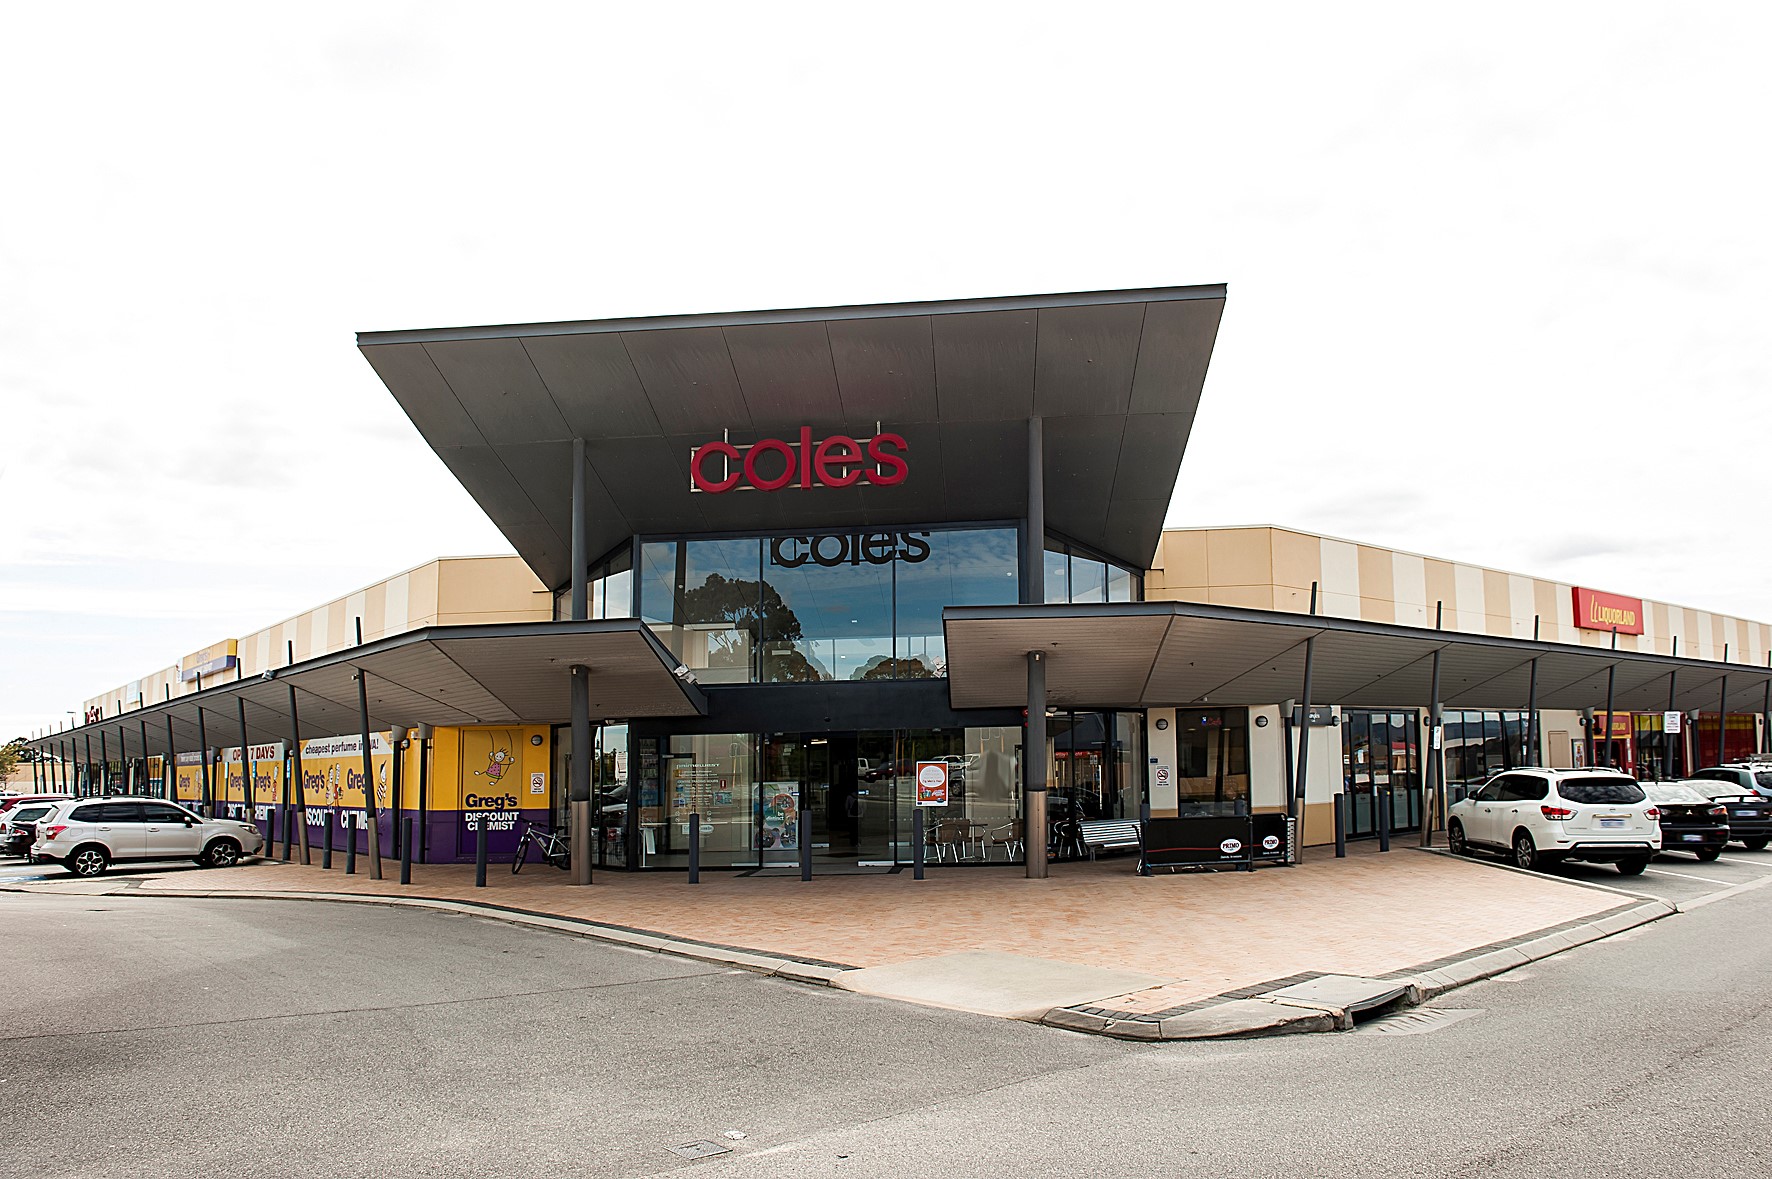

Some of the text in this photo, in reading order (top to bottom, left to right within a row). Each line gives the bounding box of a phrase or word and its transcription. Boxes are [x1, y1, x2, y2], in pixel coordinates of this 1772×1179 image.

[691, 426, 908, 494] coles
[771, 532, 931, 568] coles
[1598, 605, 1636, 626] LIQUORLAND
[250, 747, 255, 759] 7
[256, 745, 275, 759] DAYS
[305, 742, 331, 756] cheapest
[331, 742, 357, 755] perfume
[303, 769, 325, 794] Greg's
[347, 768, 366, 794] Greg
[465, 793, 518, 811] Greg's
